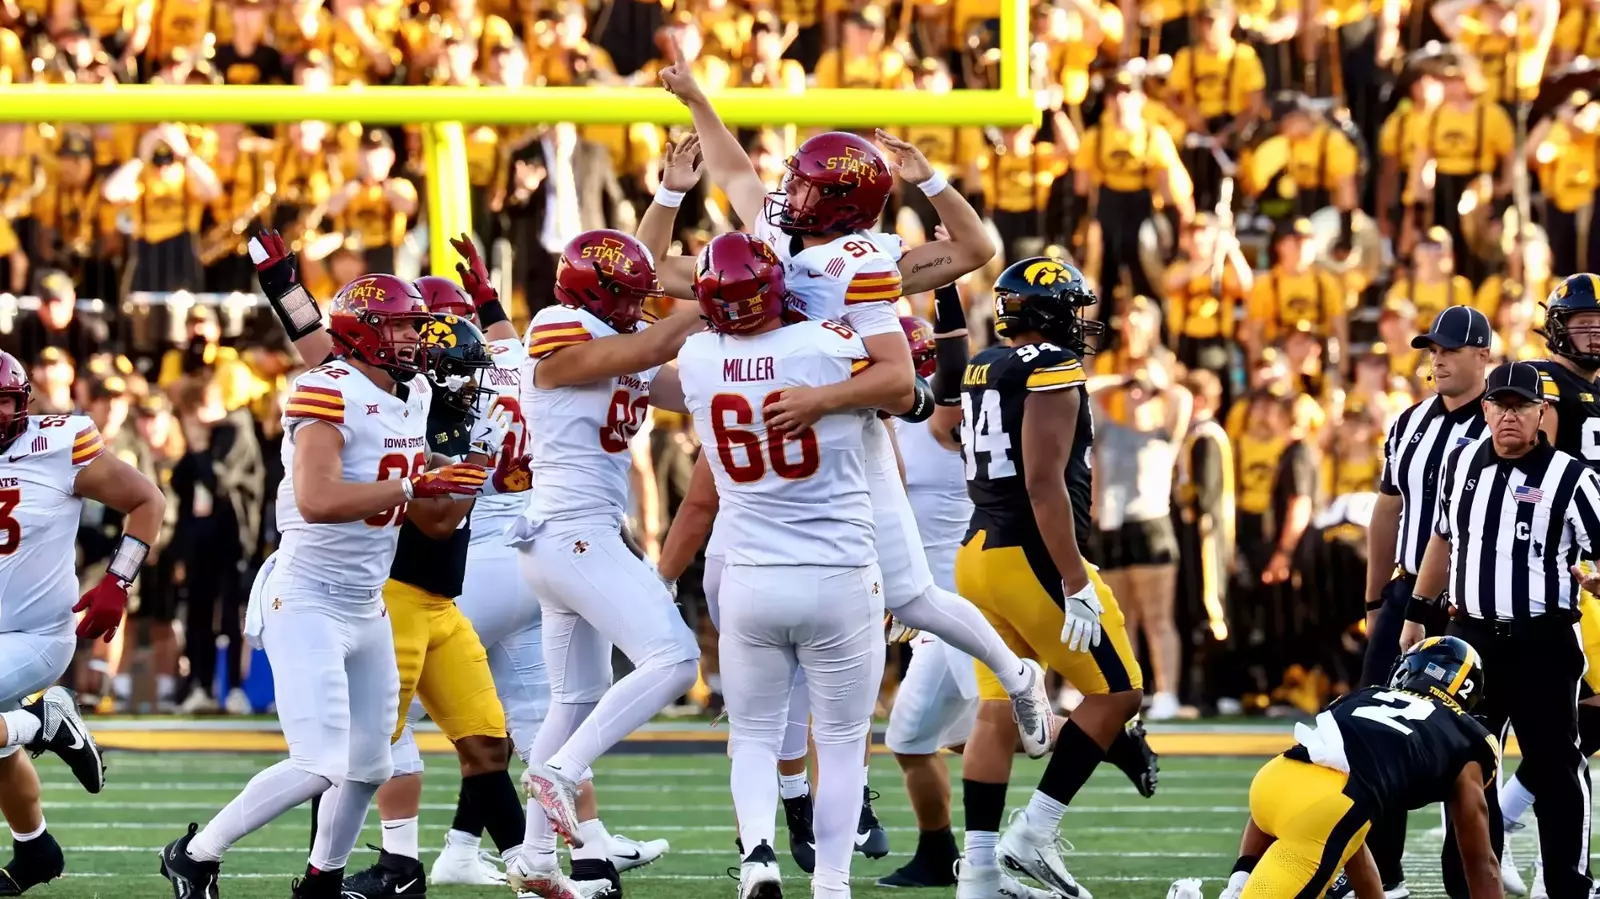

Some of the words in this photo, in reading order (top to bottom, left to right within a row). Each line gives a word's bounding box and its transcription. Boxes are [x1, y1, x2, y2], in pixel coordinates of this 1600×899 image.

[826, 156, 877, 184] STATE
[581, 246, 634, 273] STATE
[843, 240, 881, 258] 97
[1476, 335, 1484, 345] S
[1016, 342, 1062, 363] 94
[723, 356, 775, 382] MILLER
[384, 437, 407, 449] IOWA
[408, 436, 425, 449] STATE
[710, 387, 821, 484] 66
[1410, 432, 1423, 444] S
[1464, 478, 1477, 492] S
[1515, 521, 1531, 542] C
[1458, 678, 1475, 700] 2
[1351, 691, 1437, 736] 2
